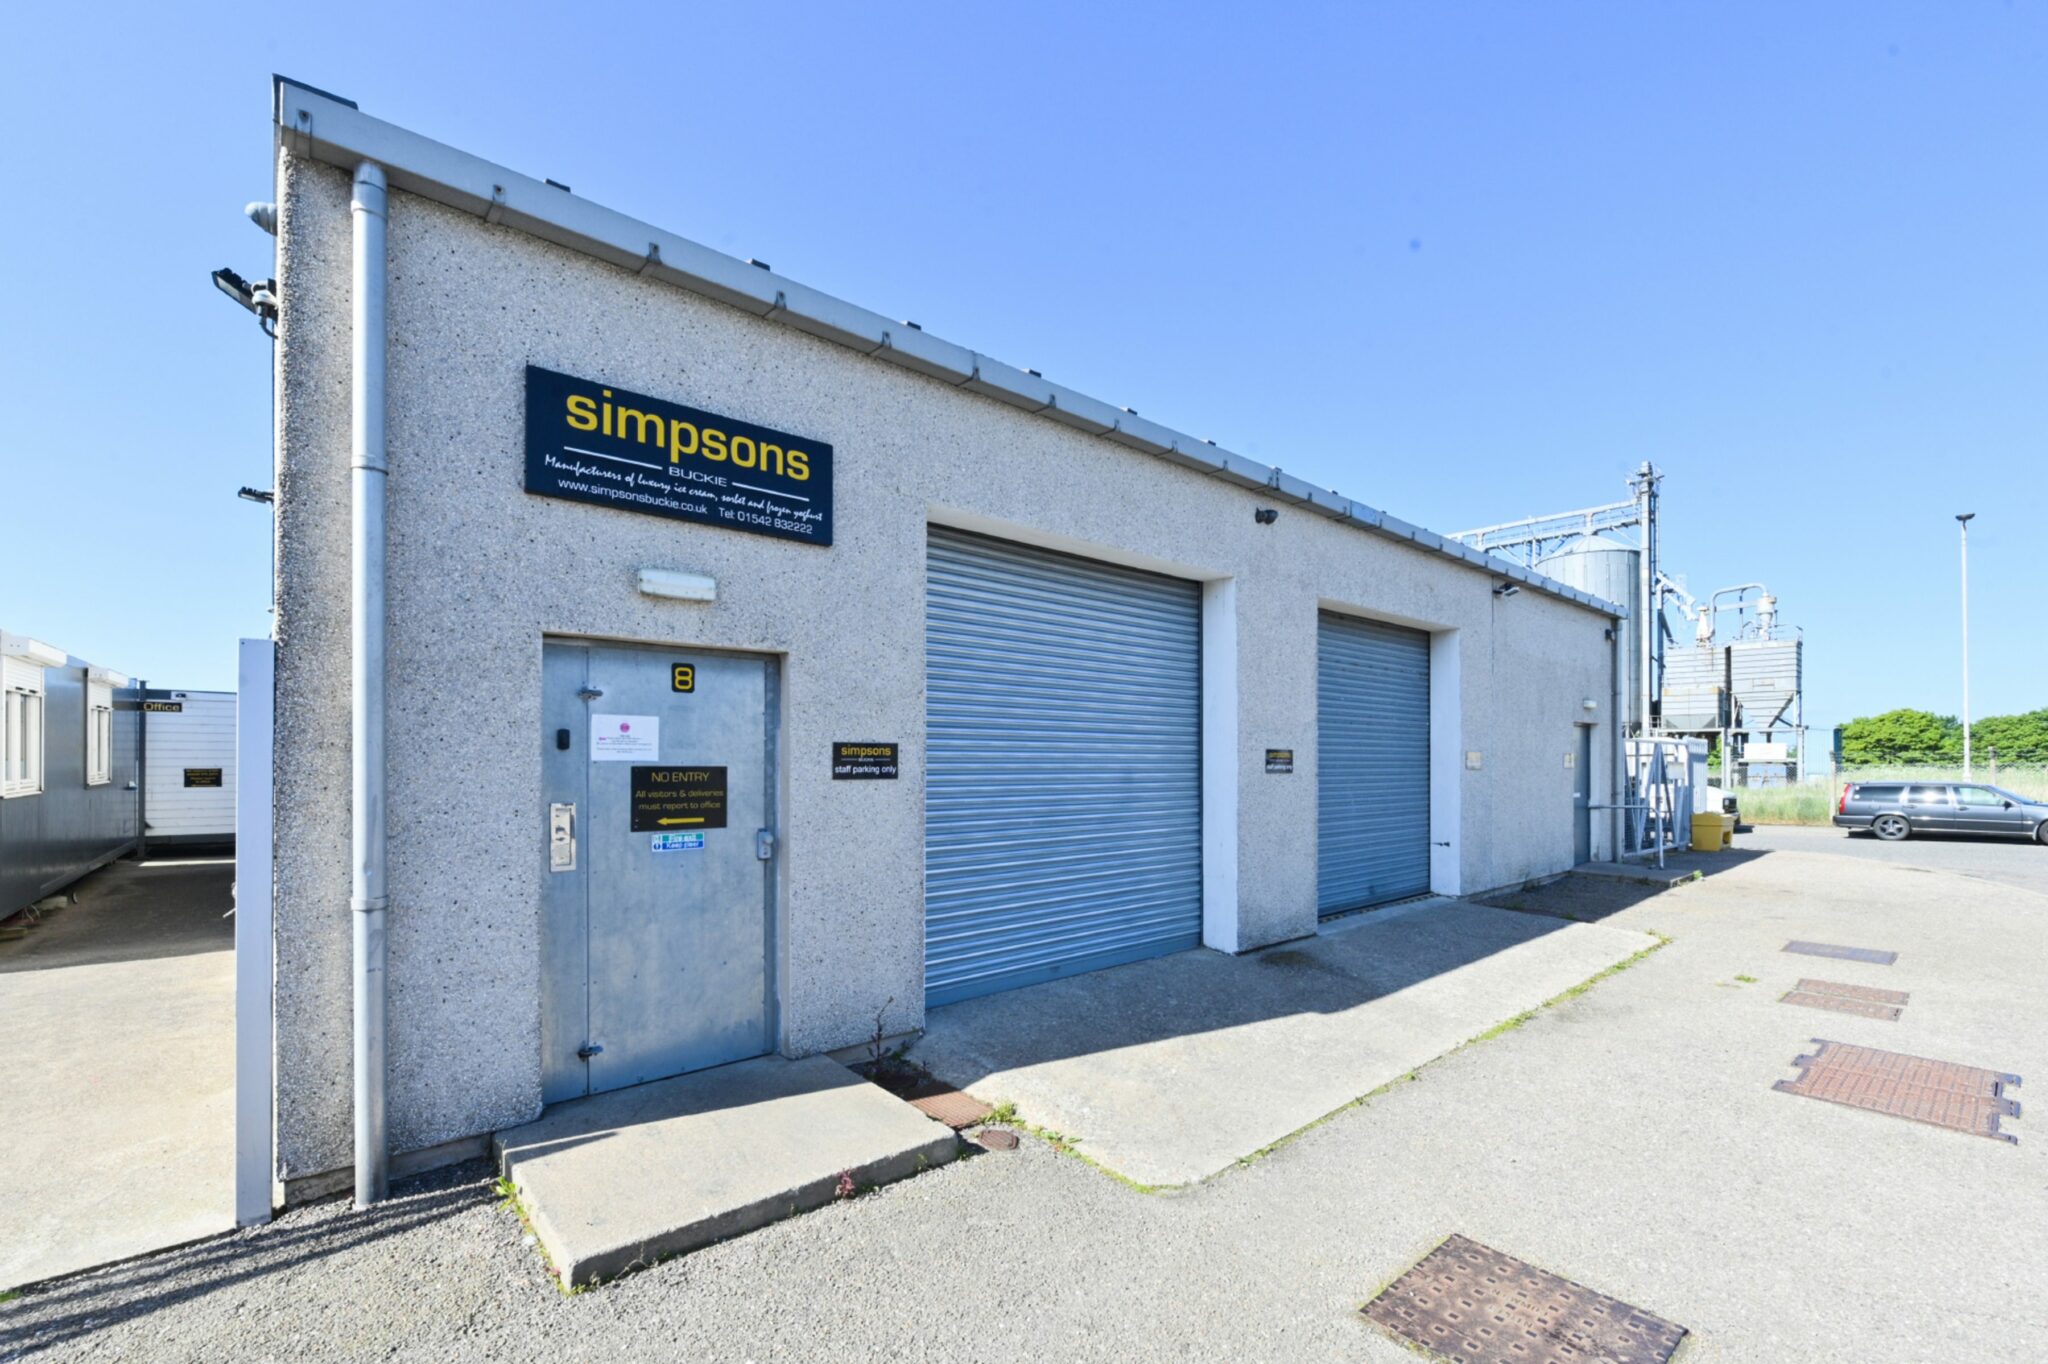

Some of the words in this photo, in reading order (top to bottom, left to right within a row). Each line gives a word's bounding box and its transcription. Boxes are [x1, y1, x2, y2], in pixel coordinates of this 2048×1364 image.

[566, 389, 810, 481] simpsons
[668, 466, 728, 487] BUCKIE
[544, 453, 622, 481] Manufacturers
[624, 472, 635, 487] of
[637, 473, 671, 494] luxury
[673, 482, 687, 493] ice
[688, 488, 719, 502] cream,
[721, 493, 746, 505] sorbet
[747, 499, 765, 509] and
[766, 501, 792, 517] frozen
[793, 508, 823, 521] yoghurt
[557, 479, 708, 514] www.simpsonsbuckie.co.uk
[737, 510, 772, 527] 01542
[774, 517, 813, 534] 832222
[674, 666, 693, 690] 8
[143, 702, 180, 711] Office
[841, 744, 892, 758] simpsons
[834, 764, 852, 773] staff
[852, 764, 880, 775] parking
[881, 764, 897, 775] only
[651, 771, 670, 783] NO
[671, 771, 711, 783] ENTRY
[635, 790, 646, 798] All
[647, 790, 678, 798] visitors
[687, 789, 724, 798] deliveries
[638, 802, 661, 810] must
[662, 802, 689, 811] report
[689, 801, 699, 809] to
